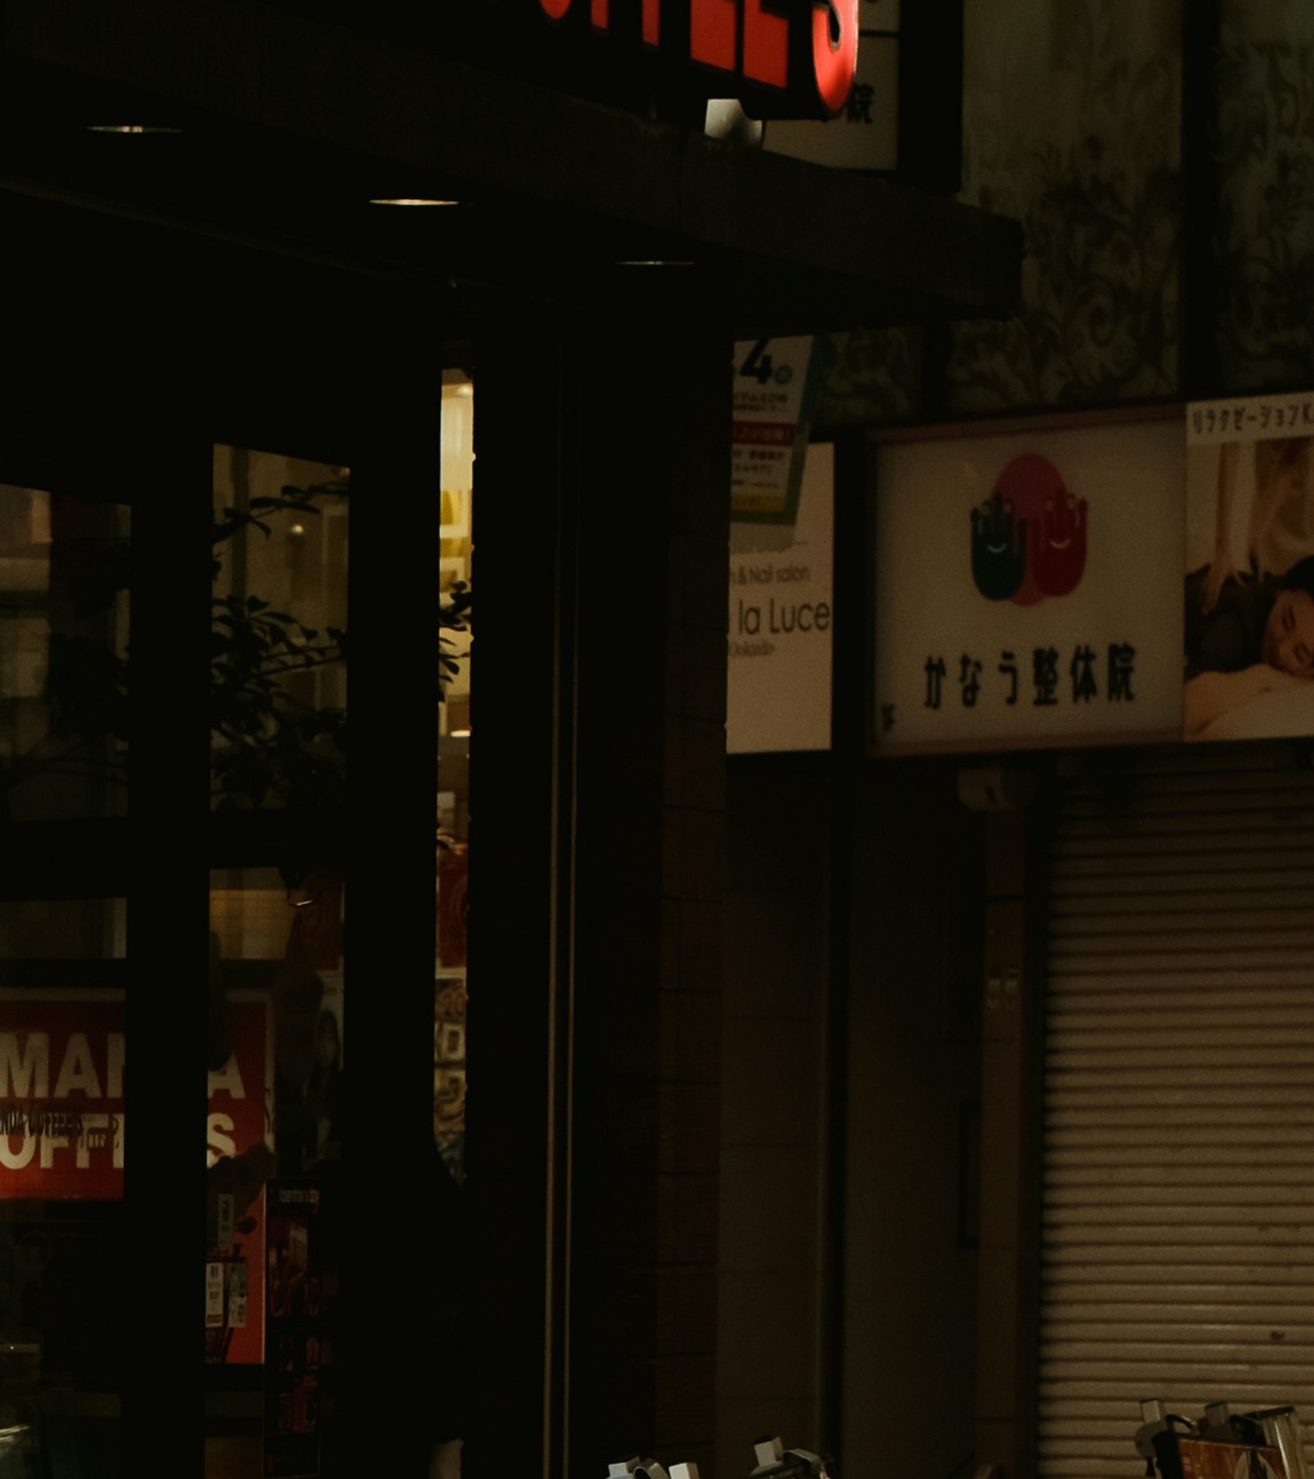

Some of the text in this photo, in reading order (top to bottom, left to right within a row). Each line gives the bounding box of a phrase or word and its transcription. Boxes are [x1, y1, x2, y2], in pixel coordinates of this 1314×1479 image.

[738, 597, 831, 634] la Luce
[924, 643, 1135, 709] かなう整体院
